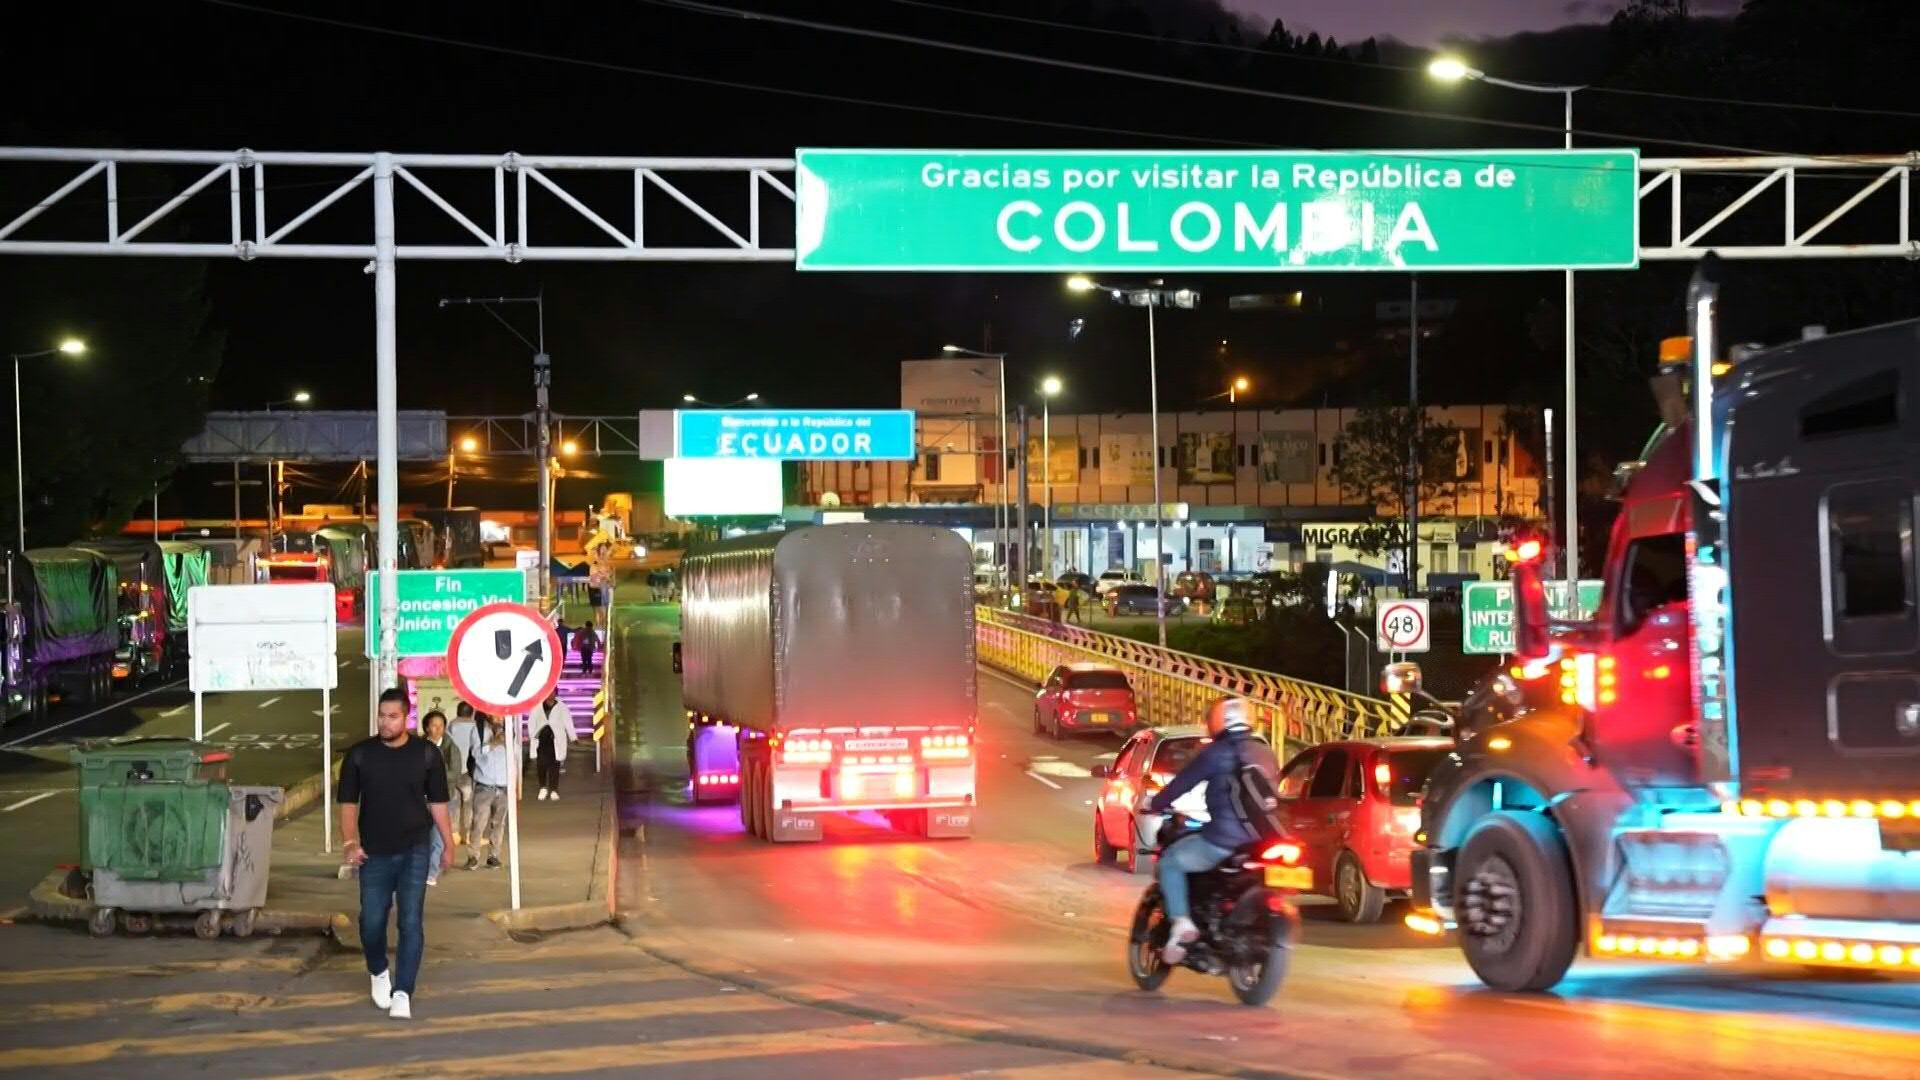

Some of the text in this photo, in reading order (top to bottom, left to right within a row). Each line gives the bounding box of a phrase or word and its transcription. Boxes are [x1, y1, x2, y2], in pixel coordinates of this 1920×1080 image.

[921, 162, 1516, 195] Gracias por visitar la República de
[720, 432, 872, 454] ECUADOR
[435, 576, 462, 592] Fin
[396, 597, 478, 612] oncesion
